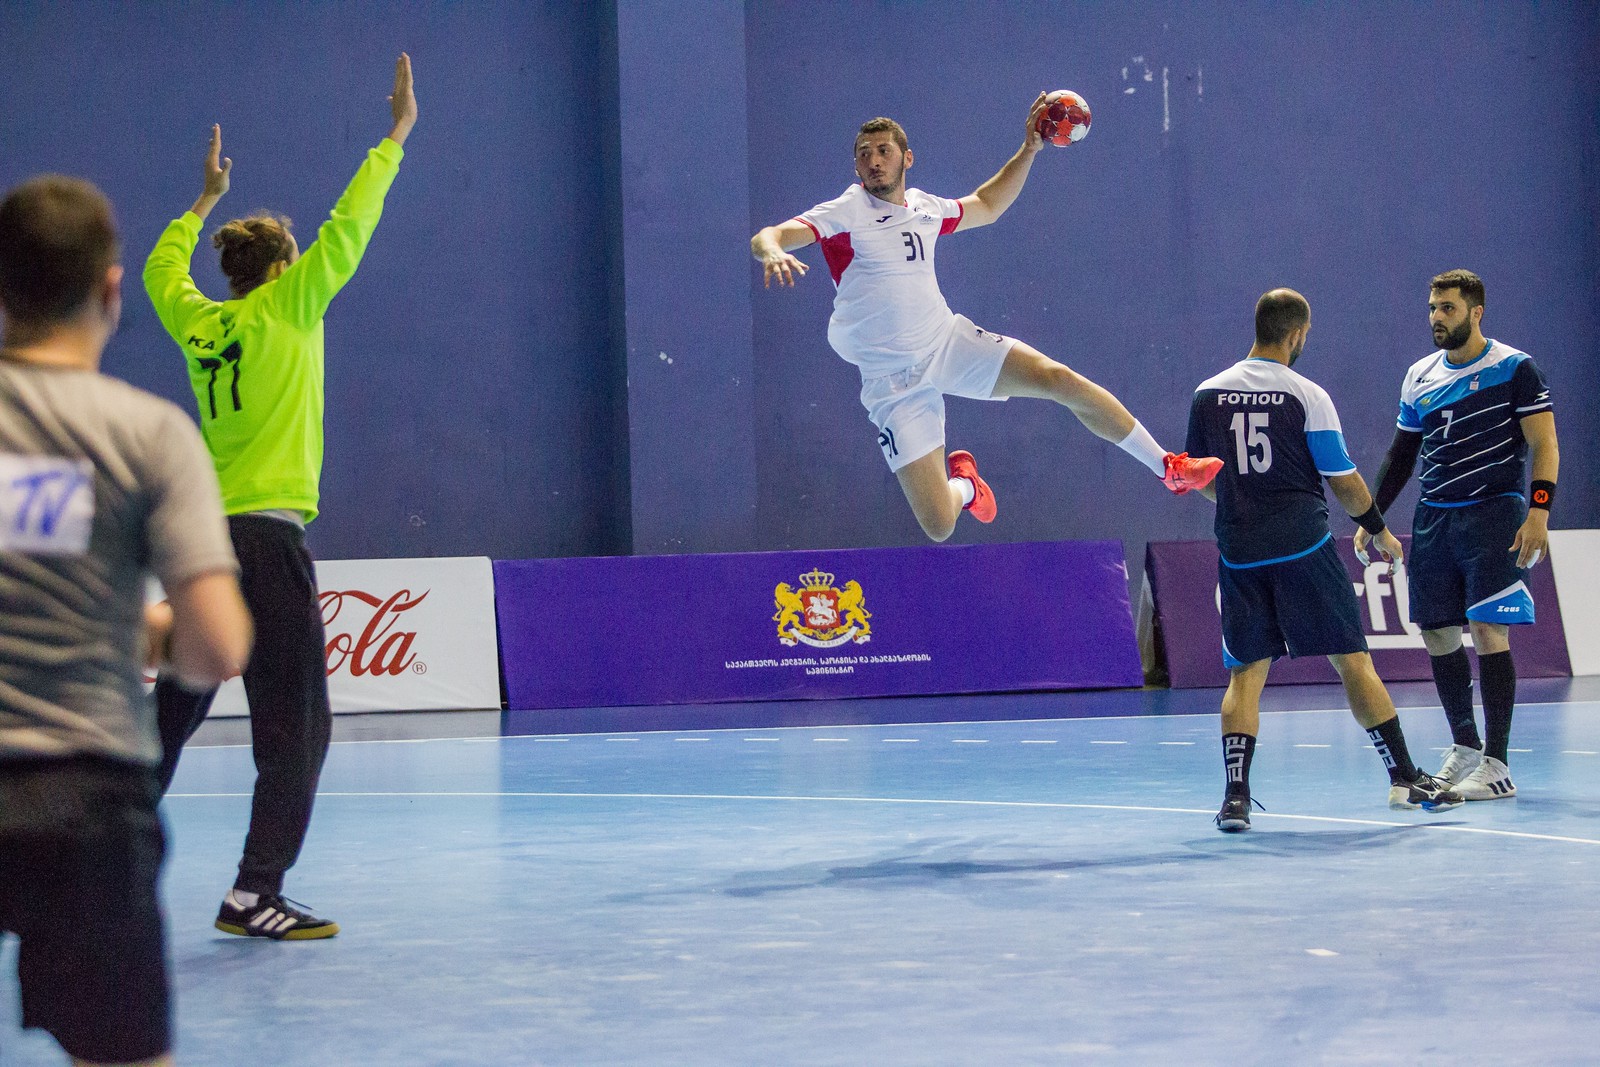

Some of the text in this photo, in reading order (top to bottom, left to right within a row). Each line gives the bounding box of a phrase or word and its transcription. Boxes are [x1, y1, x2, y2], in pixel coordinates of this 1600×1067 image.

[901, 231, 925, 261] 31
[195, 340, 243, 419] 77
[1217, 393, 1285, 405] FOTIOU
[1441, 410, 1454, 439] 7
[1229, 412, 1272, 475] 15
[1496, 605, 1520, 613] Zeus
